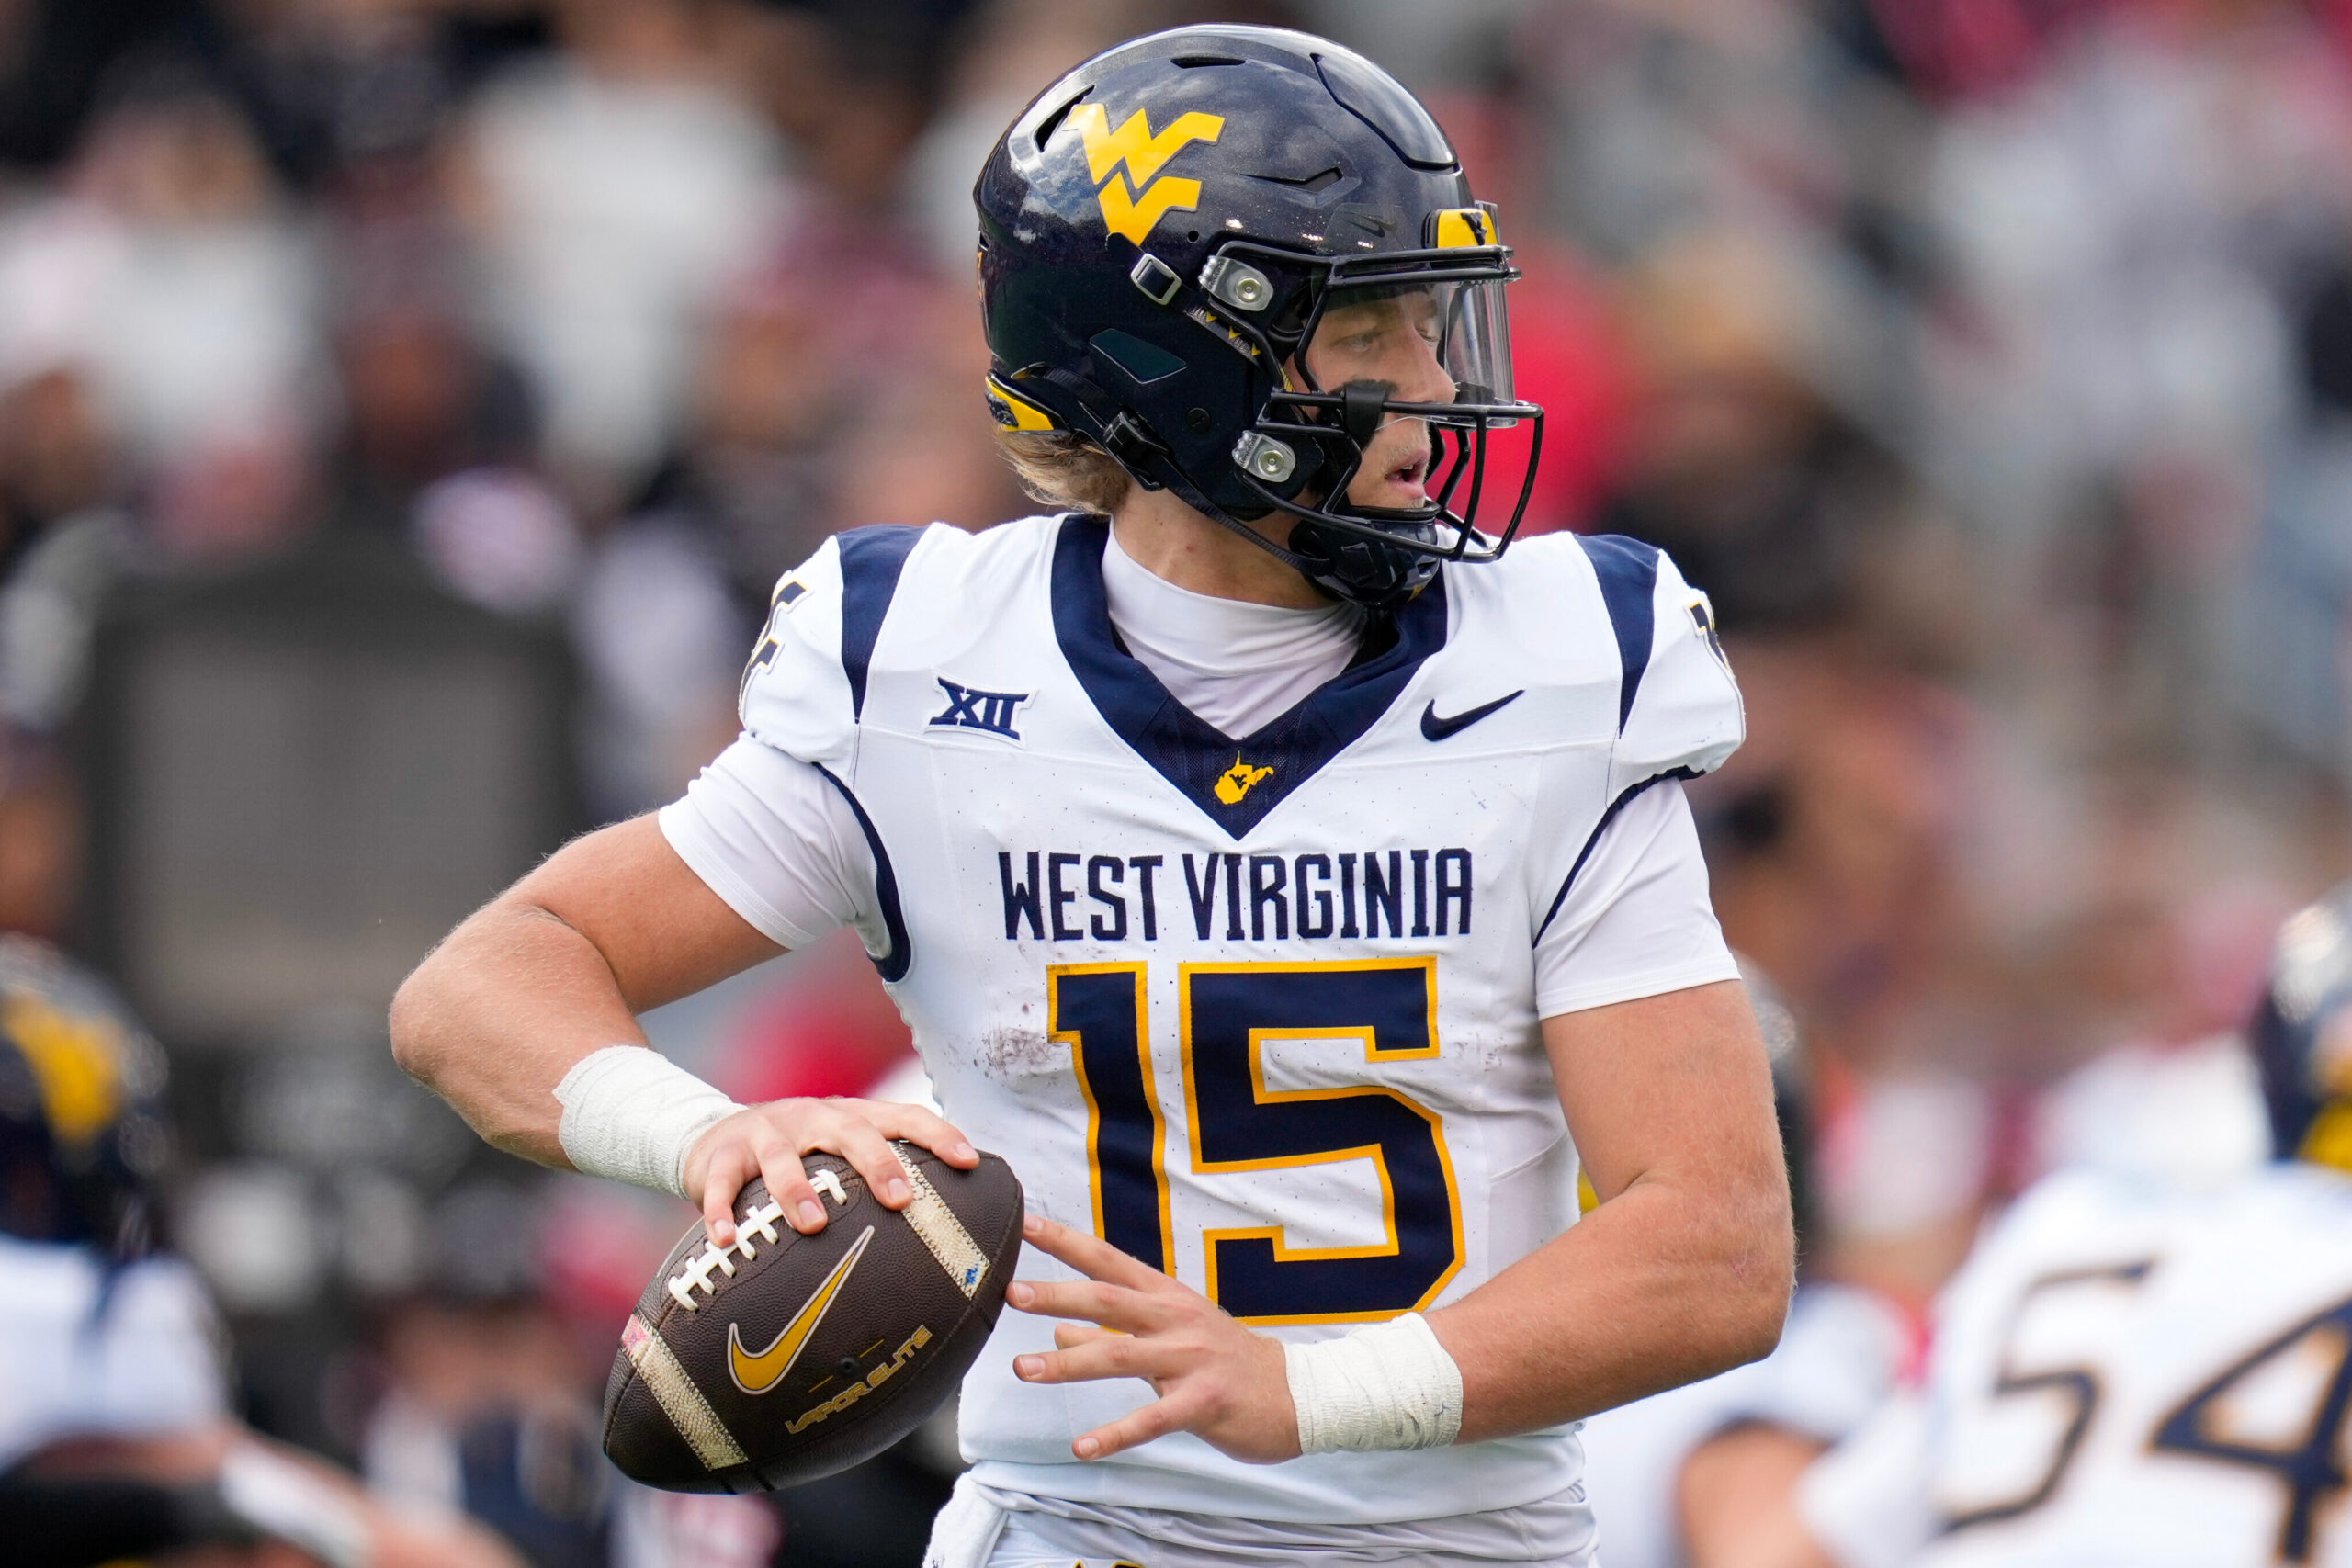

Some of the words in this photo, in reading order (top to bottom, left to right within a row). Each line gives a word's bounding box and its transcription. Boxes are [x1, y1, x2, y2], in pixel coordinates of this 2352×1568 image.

[929, 676, 1030, 741] XII
[998, 851, 1164, 942] WEST
[1182, 847, 1472, 942] VIRGINIA
[1046, 955, 1466, 1335] 15
[785, 1382, 873, 1435] VAPOR
[866, 1324, 933, 1389] ELITE
[1940, 1247, 2352, 1566] 54
